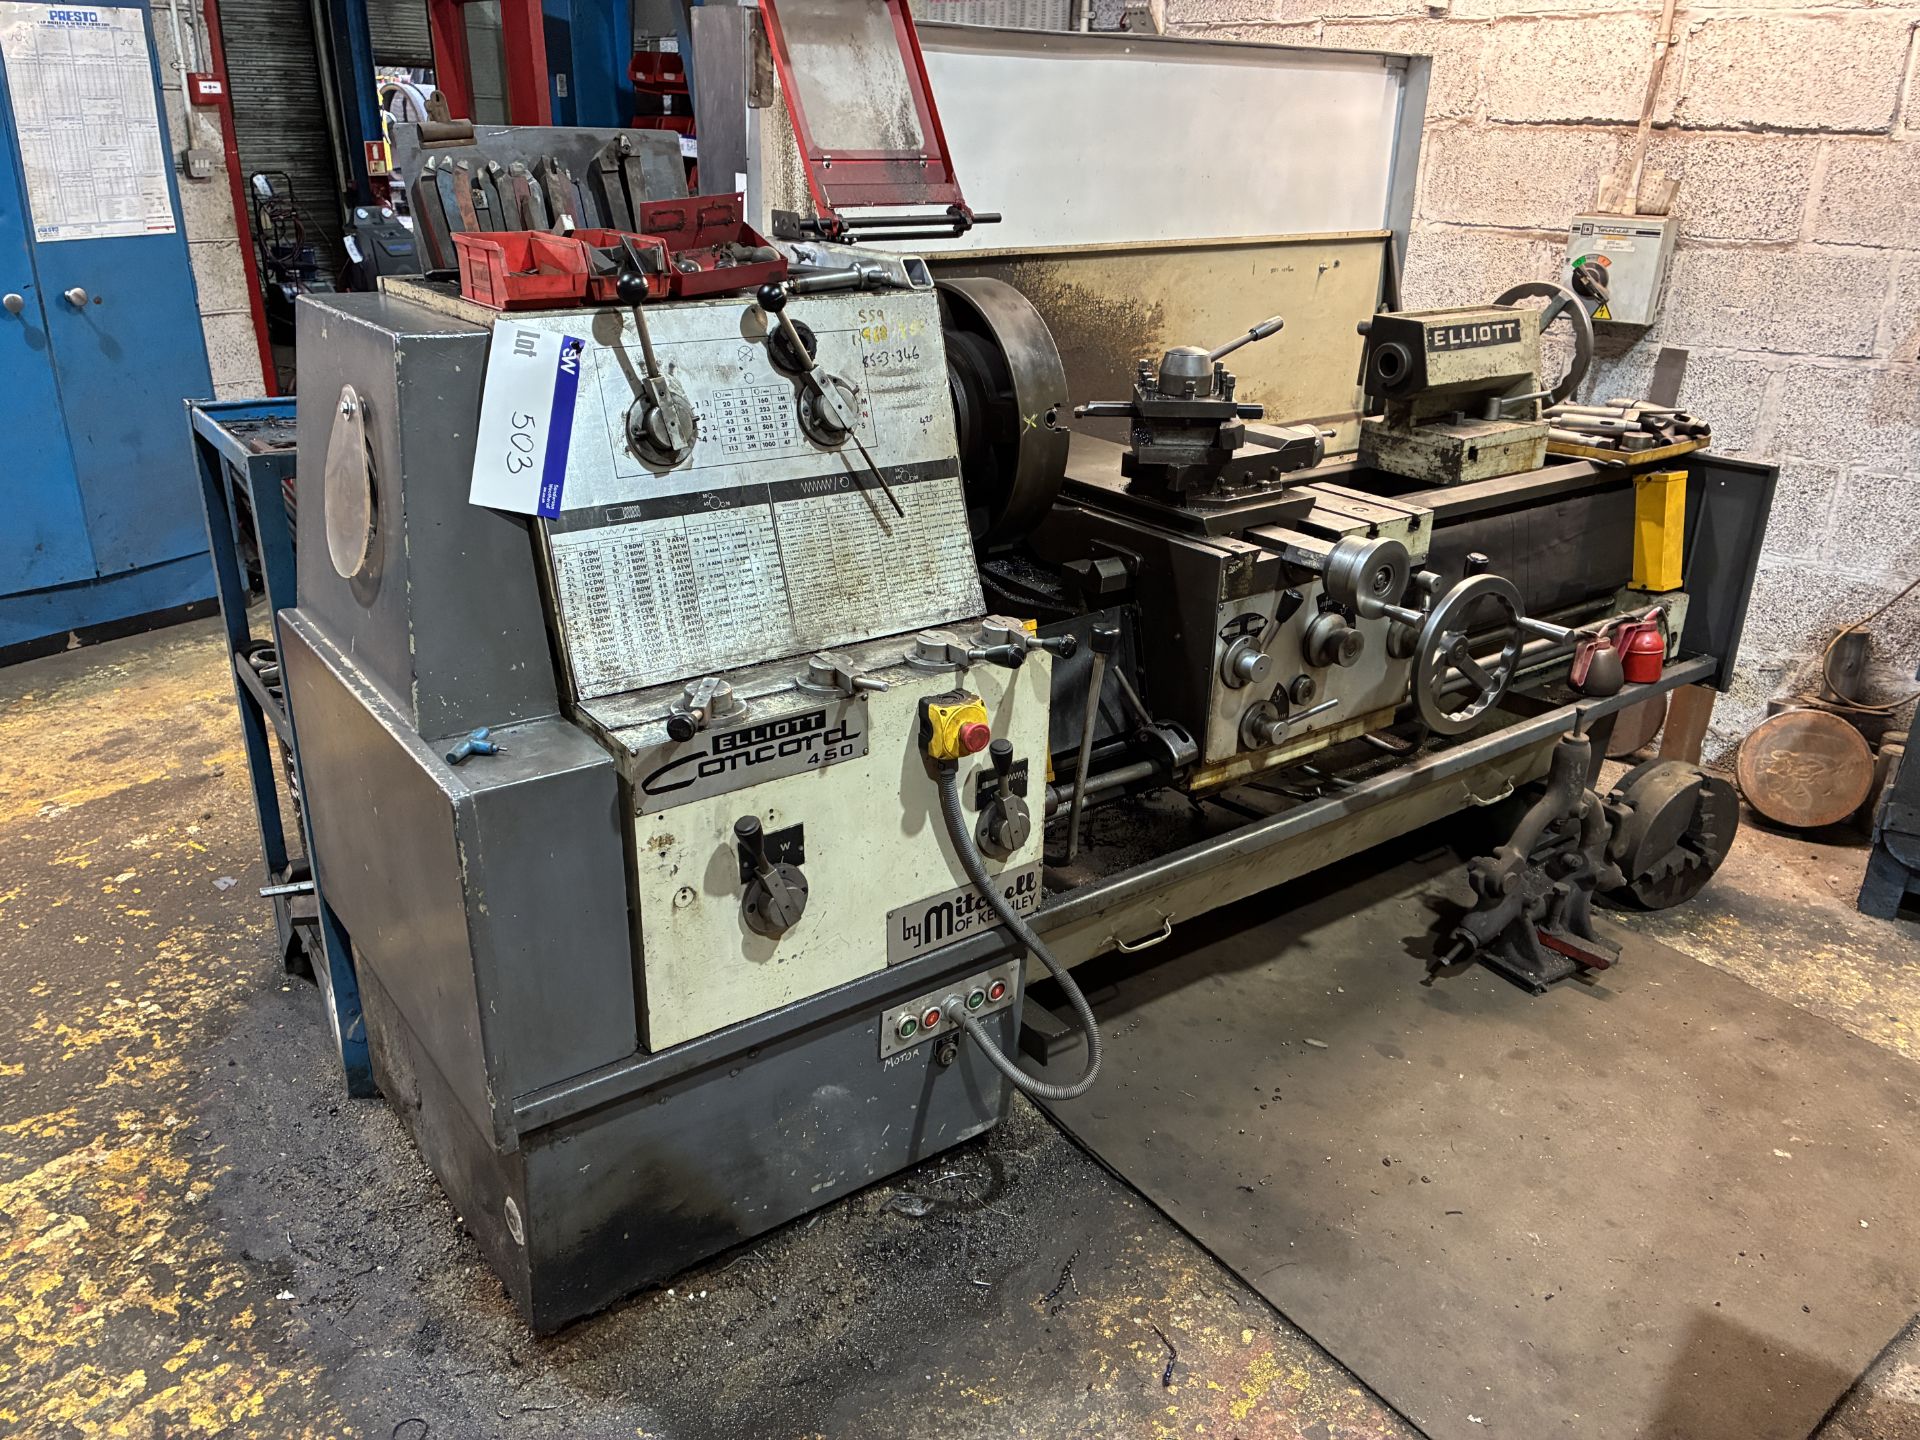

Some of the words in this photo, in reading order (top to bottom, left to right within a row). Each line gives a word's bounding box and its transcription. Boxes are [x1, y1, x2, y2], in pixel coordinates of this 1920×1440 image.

[49, 10, 98, 22] PRESTO
[513, 330, 541, 357] Lot
[1434, 323, 1515, 346] ELLIOTT
[507, 411, 535, 474] 503
[719, 714, 822, 750] ELLIOTT
[641, 719, 862, 796] Concord
[808, 744, 853, 765] 450
[780, 841, 791, 851] W
[902, 916, 922, 948] by
[924, 871, 1037, 944] Mitcell
[955, 916, 973, 932] OF
